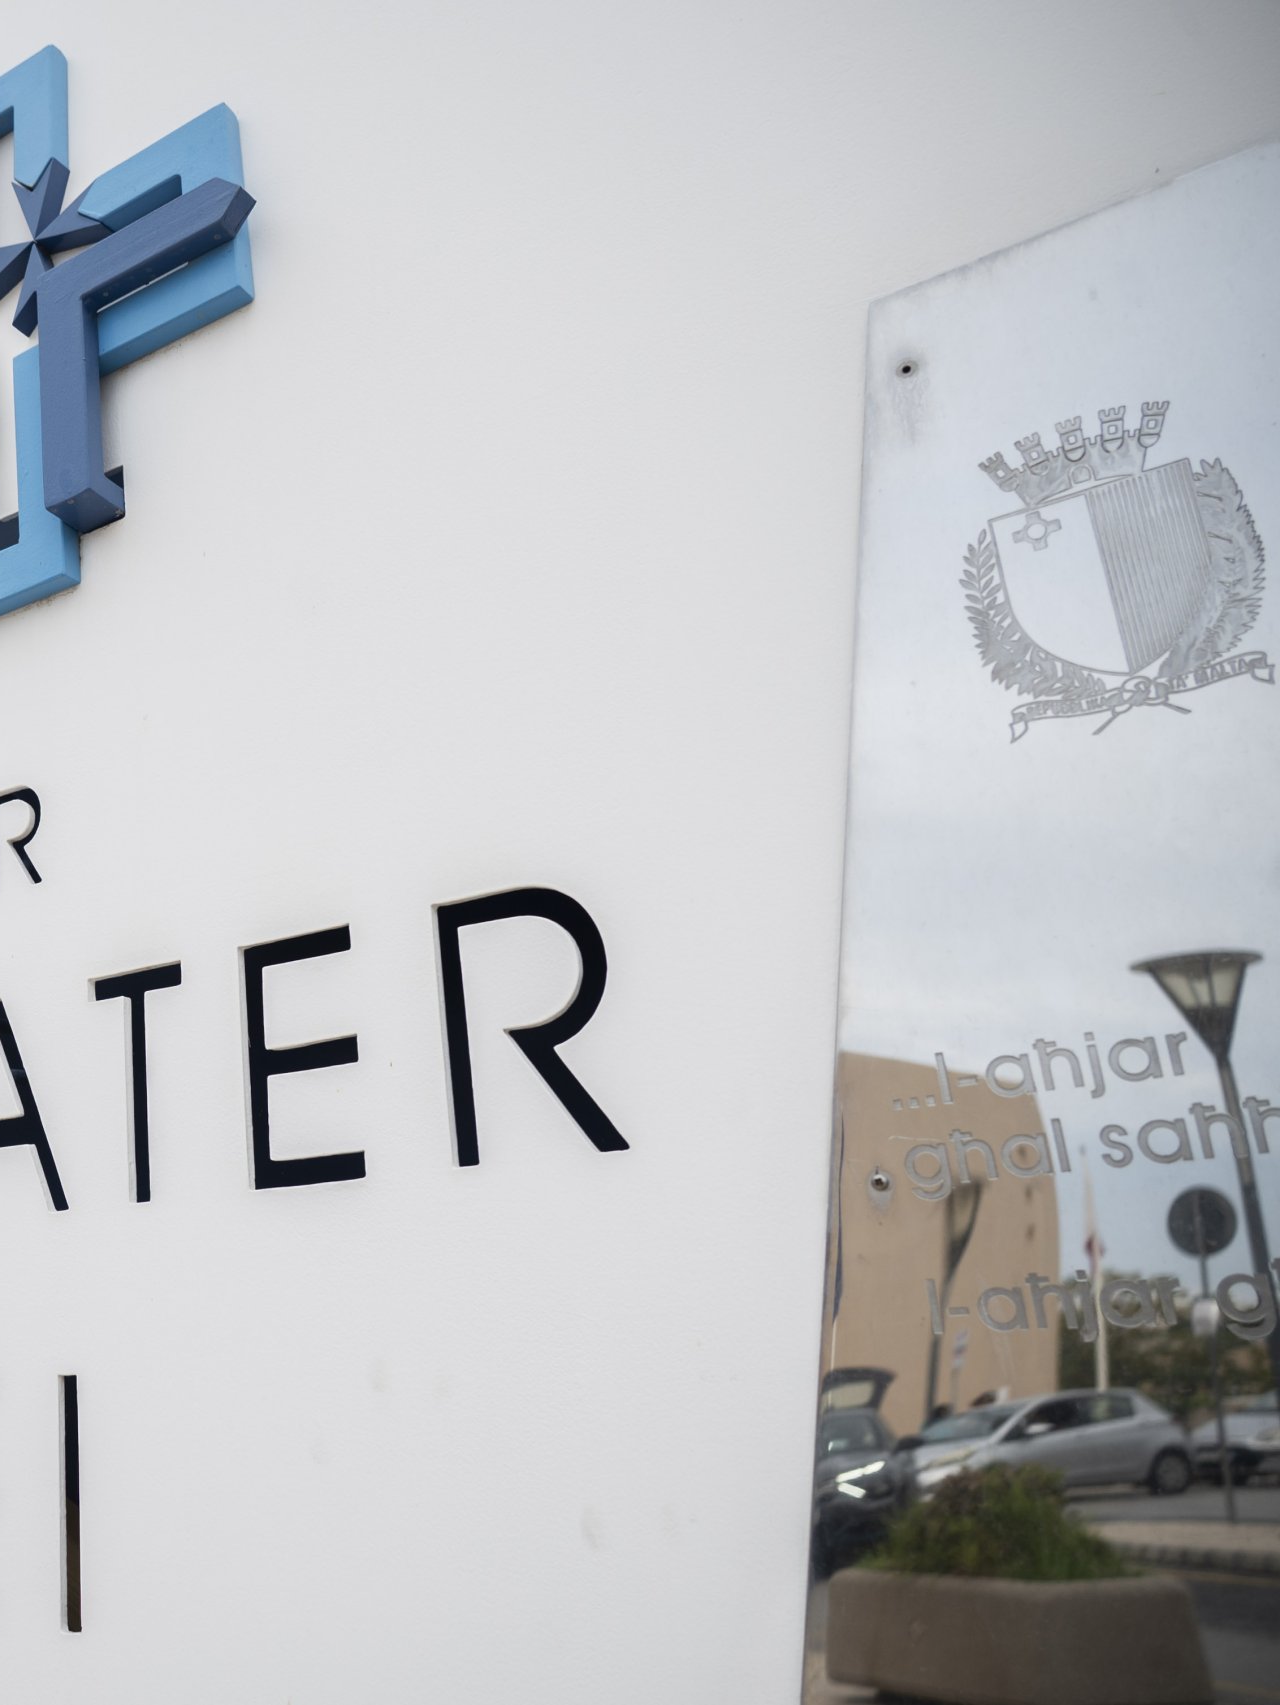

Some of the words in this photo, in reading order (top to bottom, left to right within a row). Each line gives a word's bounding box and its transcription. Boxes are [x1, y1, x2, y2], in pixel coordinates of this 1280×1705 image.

[1193, 658, 1251, 687] MALTA
[903, 1117, 1072, 1201] għal
[924, 1268, 1181, 1343] l-aħjar
[1215, 1257, 1280, 1341] g
